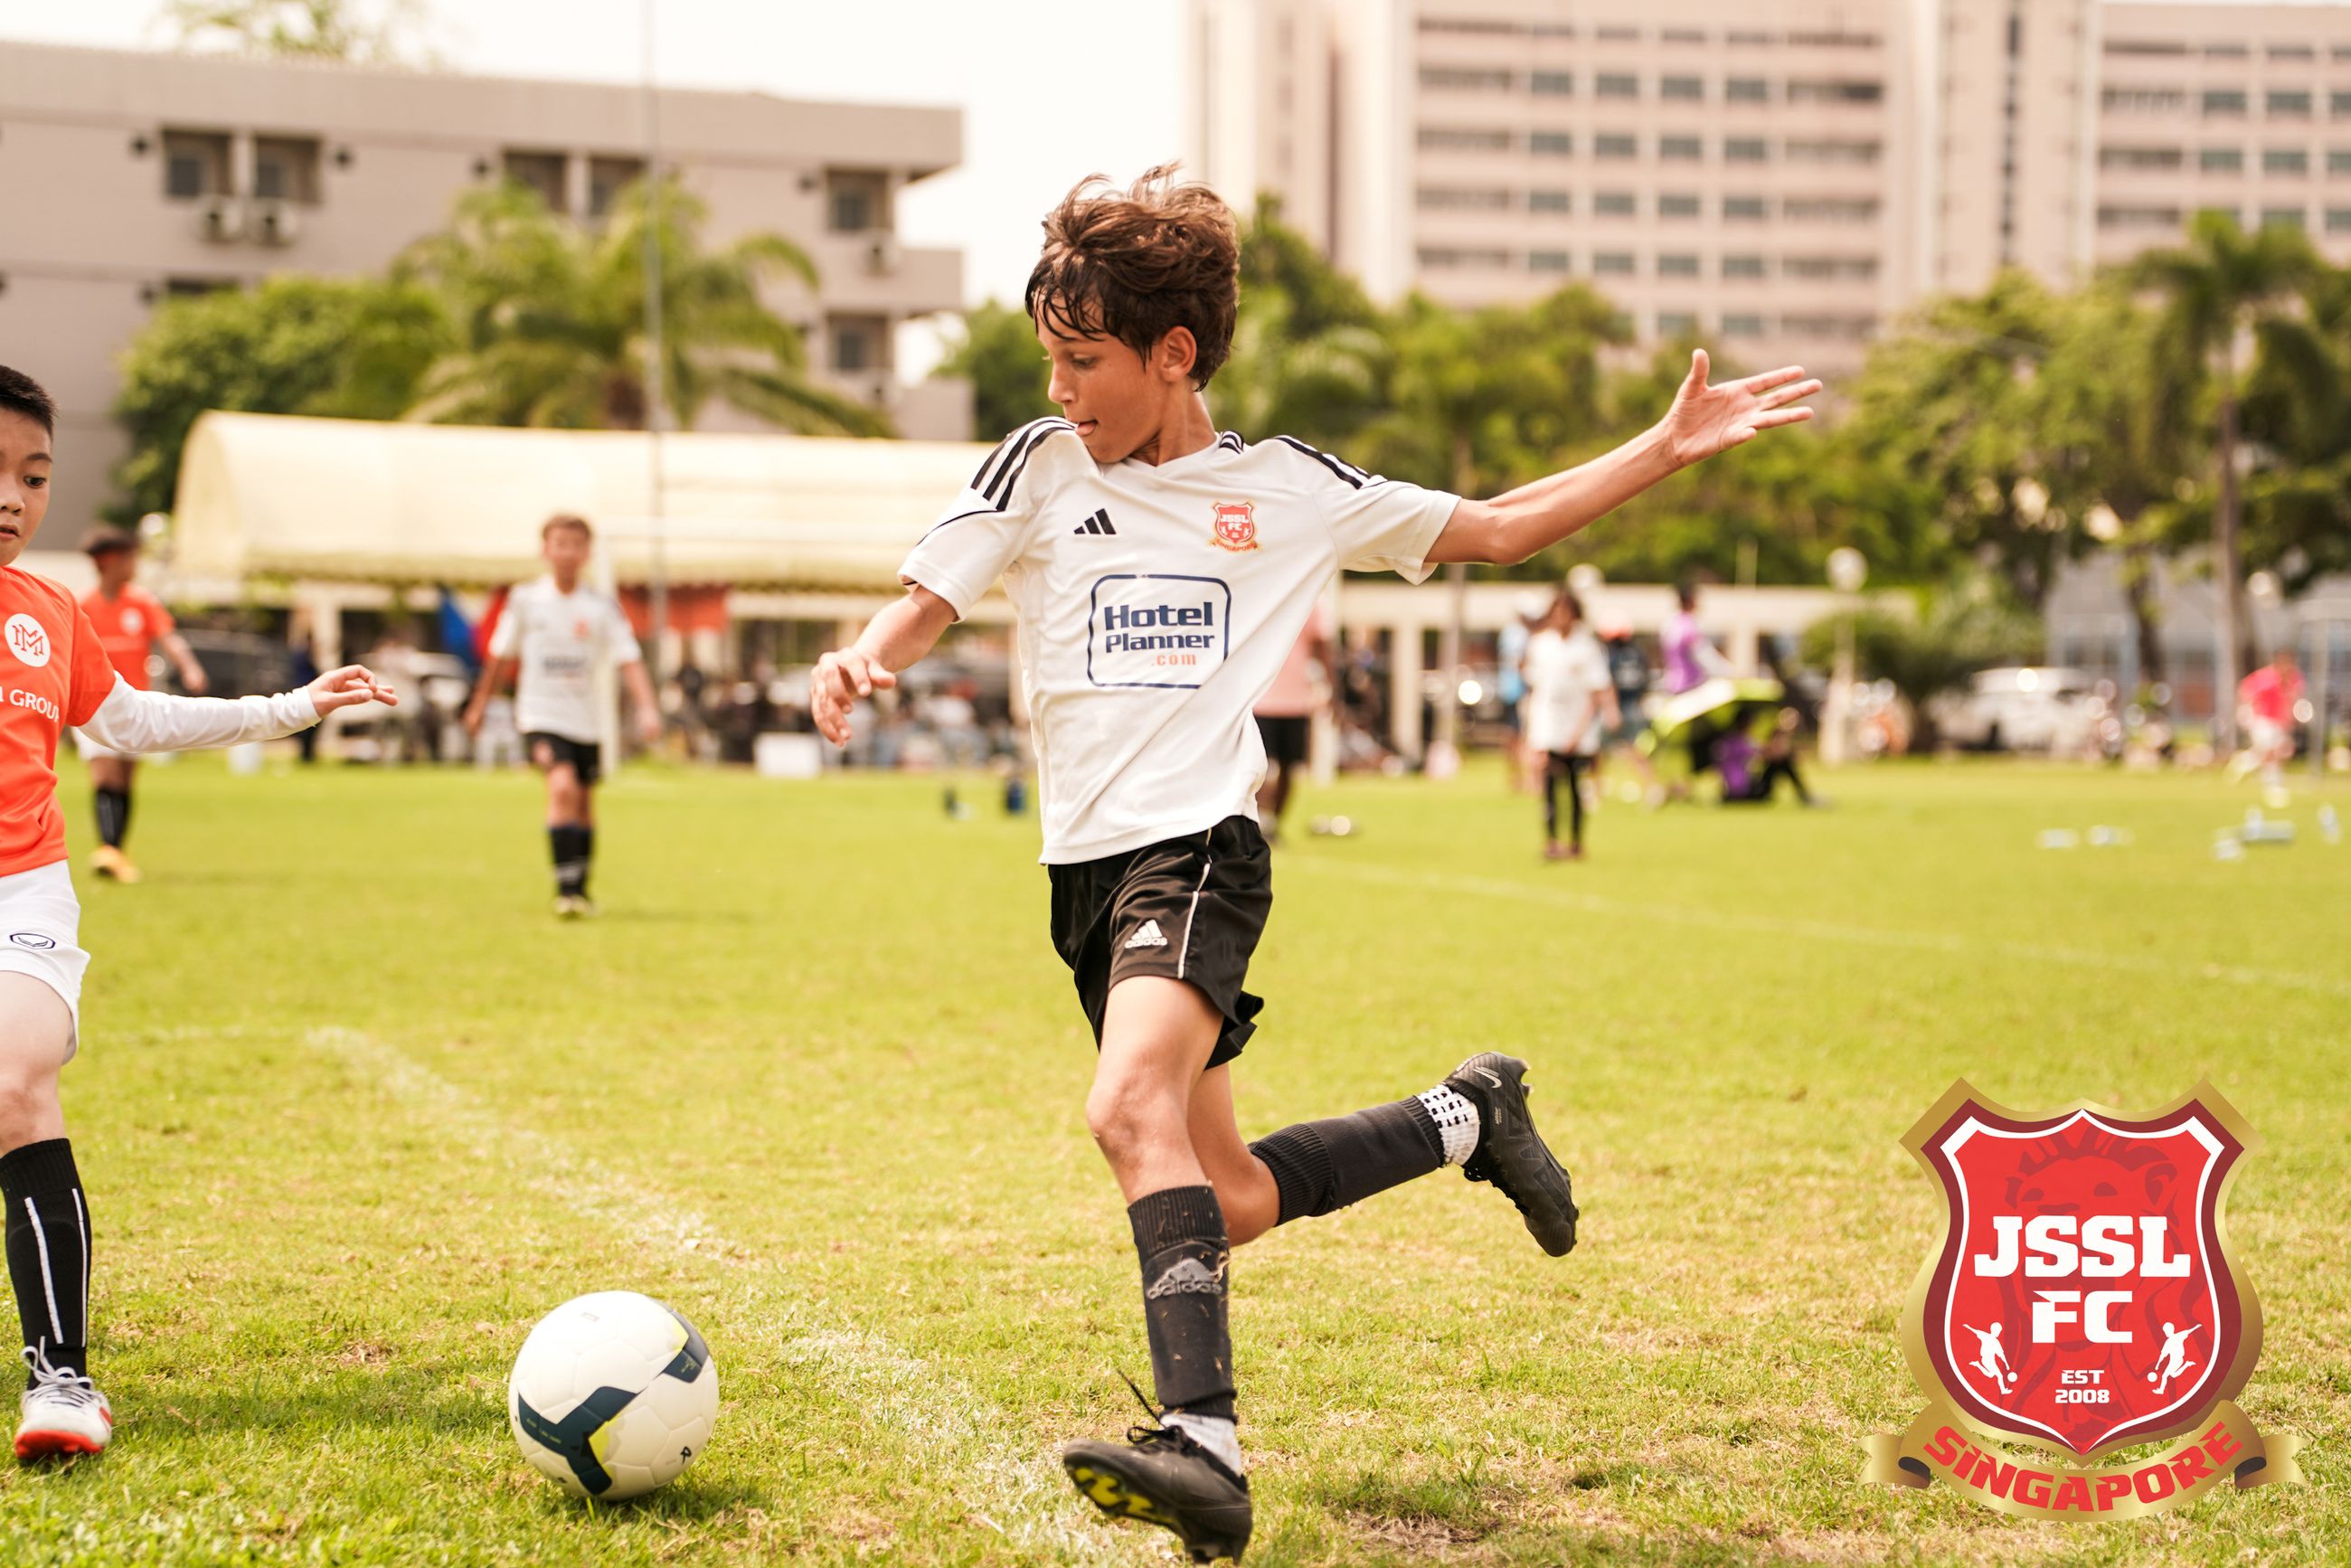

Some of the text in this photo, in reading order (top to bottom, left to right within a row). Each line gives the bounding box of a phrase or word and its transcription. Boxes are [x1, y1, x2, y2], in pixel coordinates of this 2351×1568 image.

[1104, 601, 1213, 630] Hotel
[1105, 633, 1214, 653] Planner
[1151, 654, 1197, 666] .com
